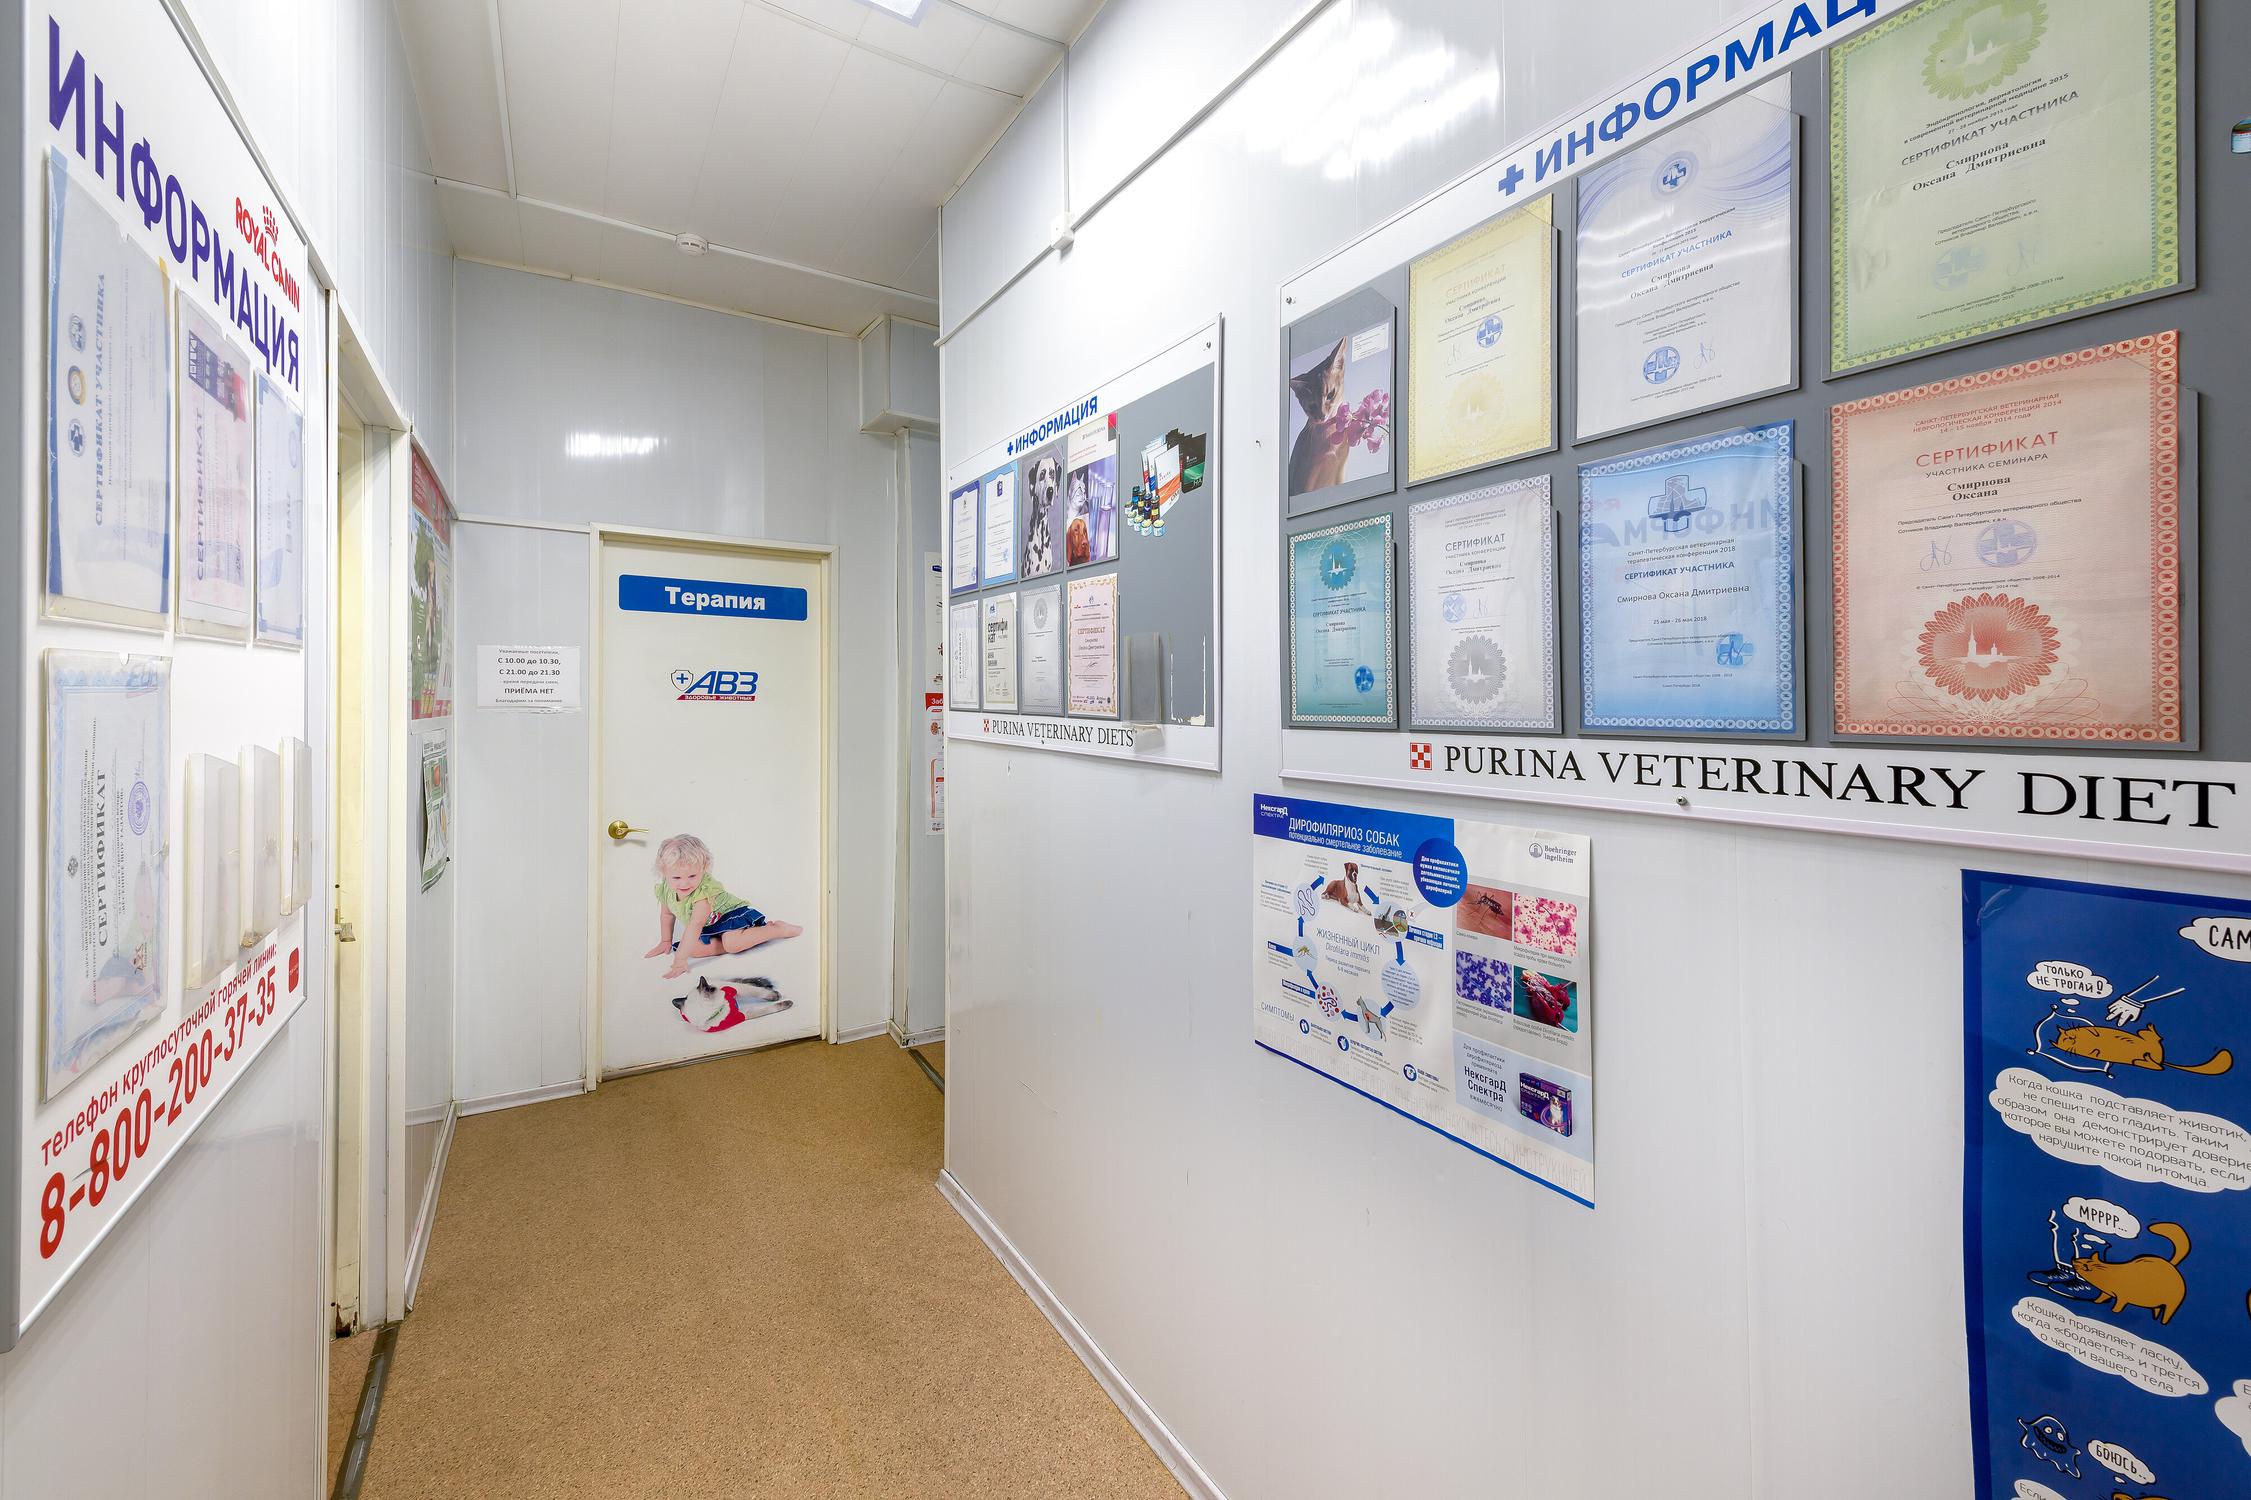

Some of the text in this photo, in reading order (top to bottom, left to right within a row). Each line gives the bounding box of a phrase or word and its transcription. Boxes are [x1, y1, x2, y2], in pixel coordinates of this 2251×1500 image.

[1910, 73, 2069, 143] современной ветеринарной медицине 2015
[1926, 78, 2042, 128] Эндокринология, дерматология
[1902, 91, 2079, 165] СЕРТИФИКАТ УЧАСТНИКА
[1913, 138, 2046, 191] Оксана Дмитриевна
[1946, 142, 2009, 169] Смирнова
[49, 15, 300, 391] ИНФОРМАЦИЯ
[236, 196, 300, 313] ROYAL CANIN
[1621, 252, 1676, 278] СЕРТИФИКАТ
[1677, 229, 1732, 256] УЧАСТНИКА
[1630, 263, 1714, 299] Оксана Дмитриевна
[1651, 264, 1691, 283] Смирнова
[96, 274, 105, 390] УЧАСТНИКА
[1016, 396, 1097, 453] ИНФОРМАЦИЯ
[1913, 400, 2062, 432] НЕВРОЛОГИЧЕСКАЯ КОНФЕРЕНЦИЯ 2014
[1915, 393, 2060, 426] САНКТ-ПЕТЕРБУРГСКАЯ ВЕТЕРИНАРНАЯ
[1916, 431, 2058, 467] СЕРТИФИКАТ
[1926, 453, 2048, 478] УЧАСТНИКА СЕМИНАРА
[1947, 476, 2011, 492] Смирнова
[1952, 489, 1998, 501] Оксана
[1445, 533, 1505, 551] СЕРТИФИКАТ
[1627, 554, 1675, 564] терапевтическая
[1676, 549, 1719, 558] конференция
[1628, 538, 1735, 557] Санкт-Петербургская ветеринарная
[1625, 561, 1735, 580] СЕРТИФИКАТ УЧАСТНИКА
[665, 586, 765, 611] Терапия
[1617, 585, 1749, 603] Смирнова Оксана Дмитриевна
[684, 671, 759, 694] АВЗ
[992, 720, 1134, 747] PURINA VETERINARY DIETS
[1444, 744, 1587, 781] PURINA
[1596, 752, 1986, 810] VETERINARY
[1260, 804, 1288, 816] НексгарД
[1289, 817, 1400, 847] ДИРОФИЛЯРИОЗ СОБАК
[1289, 832, 1403, 857] потенциально смертельное заболевание
[97, 770, 107, 947] СЕРТИФИКАТ
[1545, 845, 1577, 857] Boehringer
[1545, 853, 1574, 864] Ingelheim
[1317, 928, 1380, 955] ЖИЗНЕННЫЙ ЦИКЛ
[1326, 942, 1349, 957] Dirofilaria
[2036, 976, 2050, 986] НЕ
[2044, 964, 2084, 979] ТОЛЬКО
[1261, 1001, 1294, 1021] СИМПТОМЫ
[41, 944, 277, 1167] телефон круглосуточной горячей линии:
[1464, 1066, 1506, 1092] НексгарД
[1468, 1080, 1503, 1102] Спектра
[40, 966, 275, 1259] 8-800-200-37-35
[2009, 1074, 2247, 1143] Когда кошка подставляет животик,
[2023, 1092, 2229, 1150] не спешите его гладить. Таким
[1998, 1097, 2047, 1116] образом
[2054, 1112, 2075, 1124] она
[2082, 1121, 2188, 1153] демонстрирует
[2004, 1111, 2051, 1129] которое
[2055, 1125, 2071, 1136] вы
[2073, 1129, 2125, 1150] можете
[2210, 1168, 2245, 1184] если
[2039, 1134, 2209, 1188] нарушите покой питомца.
[2027, 1300, 2066, 1324] Кошка
[2069, 1316, 2136, 1351] проявляет
[2017, 1310, 2200, 1390] когда «бодается» и трется
[2040, 1333, 2176, 1395] о части вашего тела.
